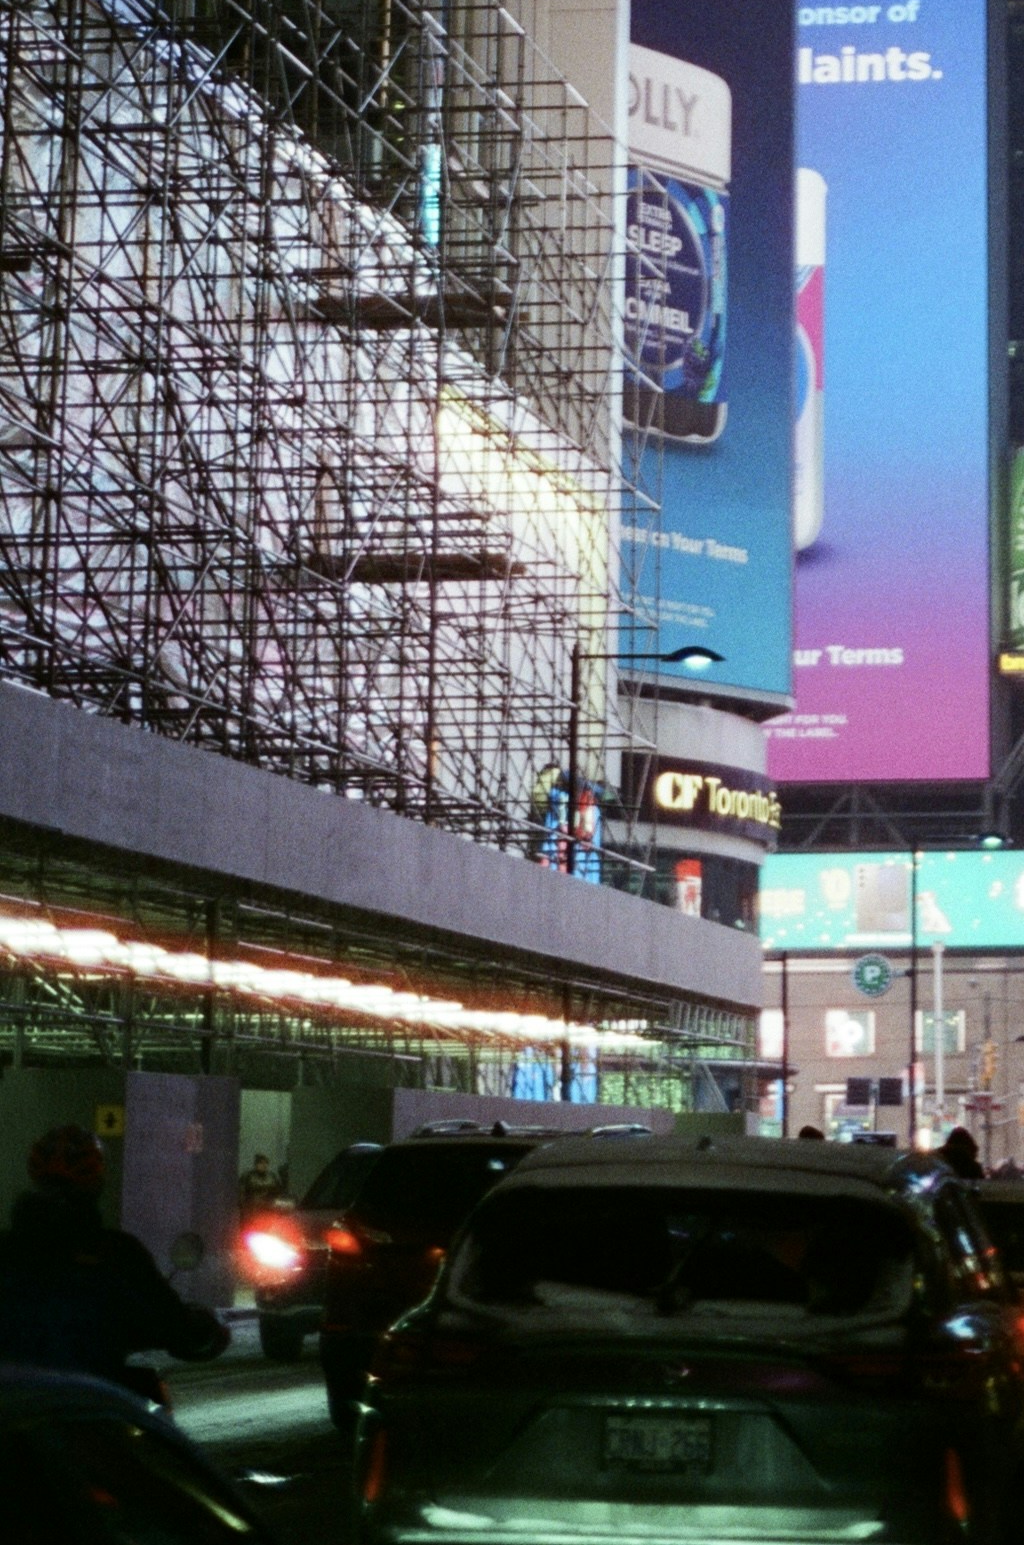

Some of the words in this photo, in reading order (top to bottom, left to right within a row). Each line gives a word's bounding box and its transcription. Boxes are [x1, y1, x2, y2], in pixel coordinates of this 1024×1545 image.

[886, 0, 921, 24] of
[800, 46, 943, 85] laints.
[627, 225, 683, 257] SLEEP
[826, 645, 905, 666] Terms
[654, 771, 703, 810] CF
[704, 777, 769, 824] Toronto
